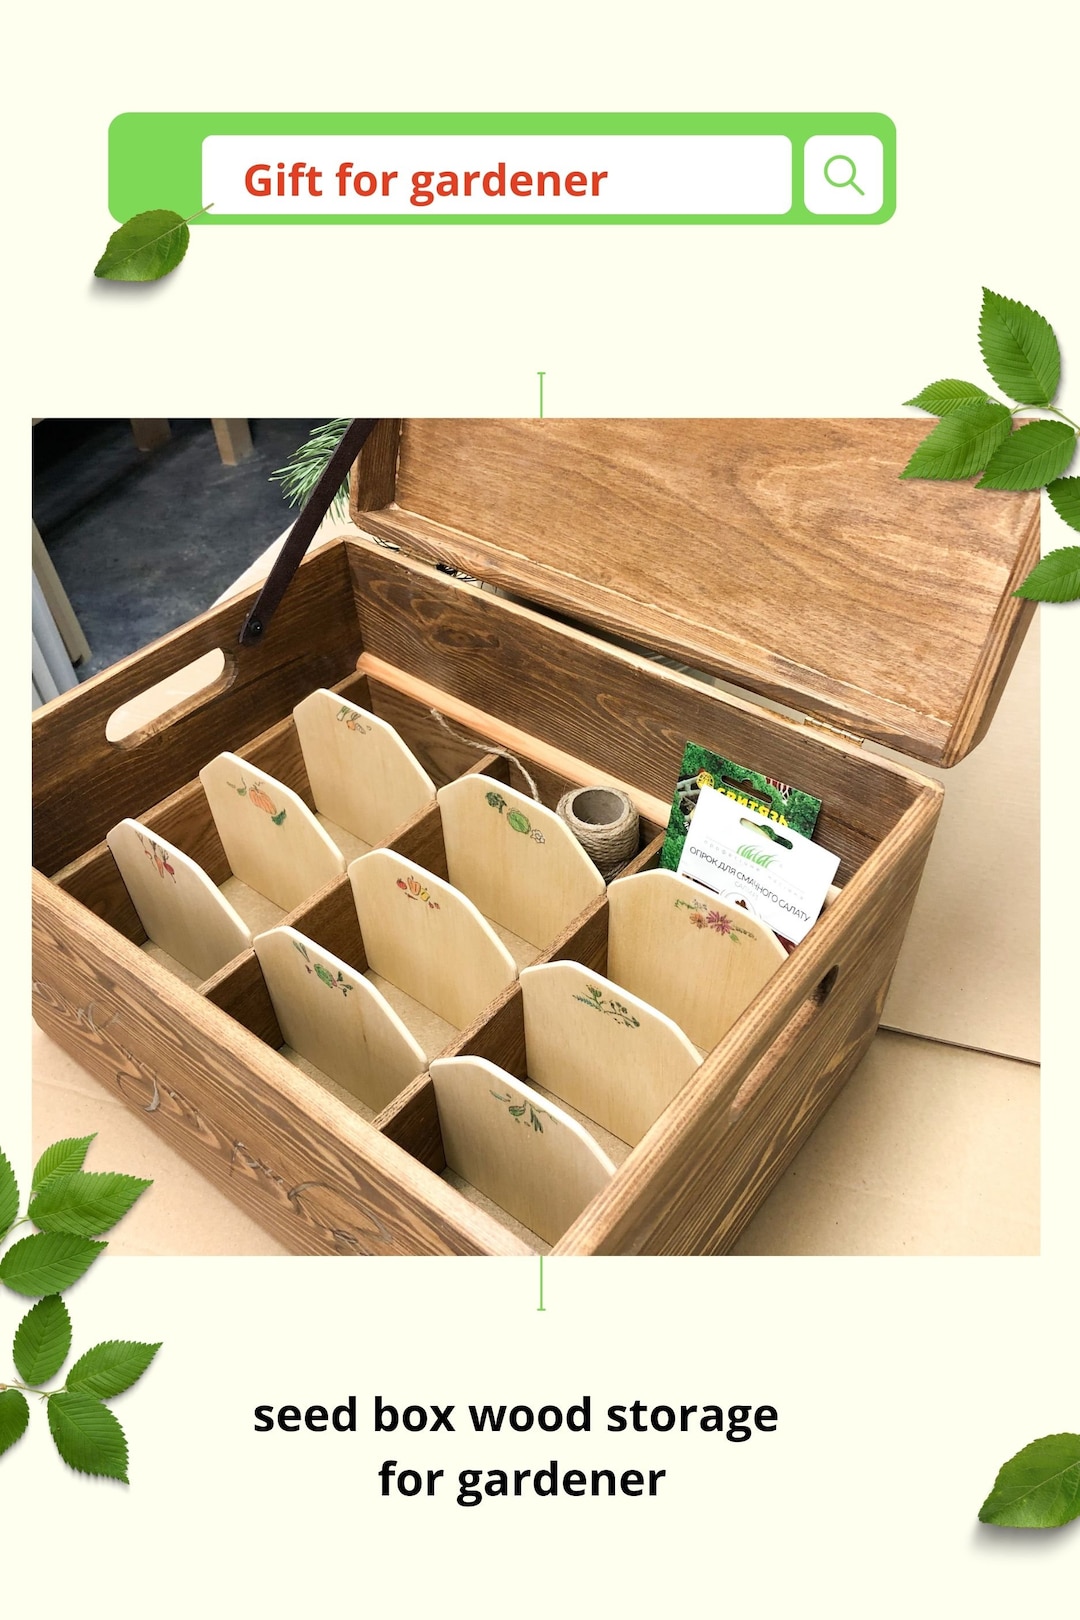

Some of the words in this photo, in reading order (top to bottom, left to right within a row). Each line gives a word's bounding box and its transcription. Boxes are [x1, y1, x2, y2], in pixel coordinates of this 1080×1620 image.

[717, 861, 737, 876] ДЛЯ
[736, 871, 779, 903] СМАЧНОГО
[778, 898, 811, 922] САЛАТУ
